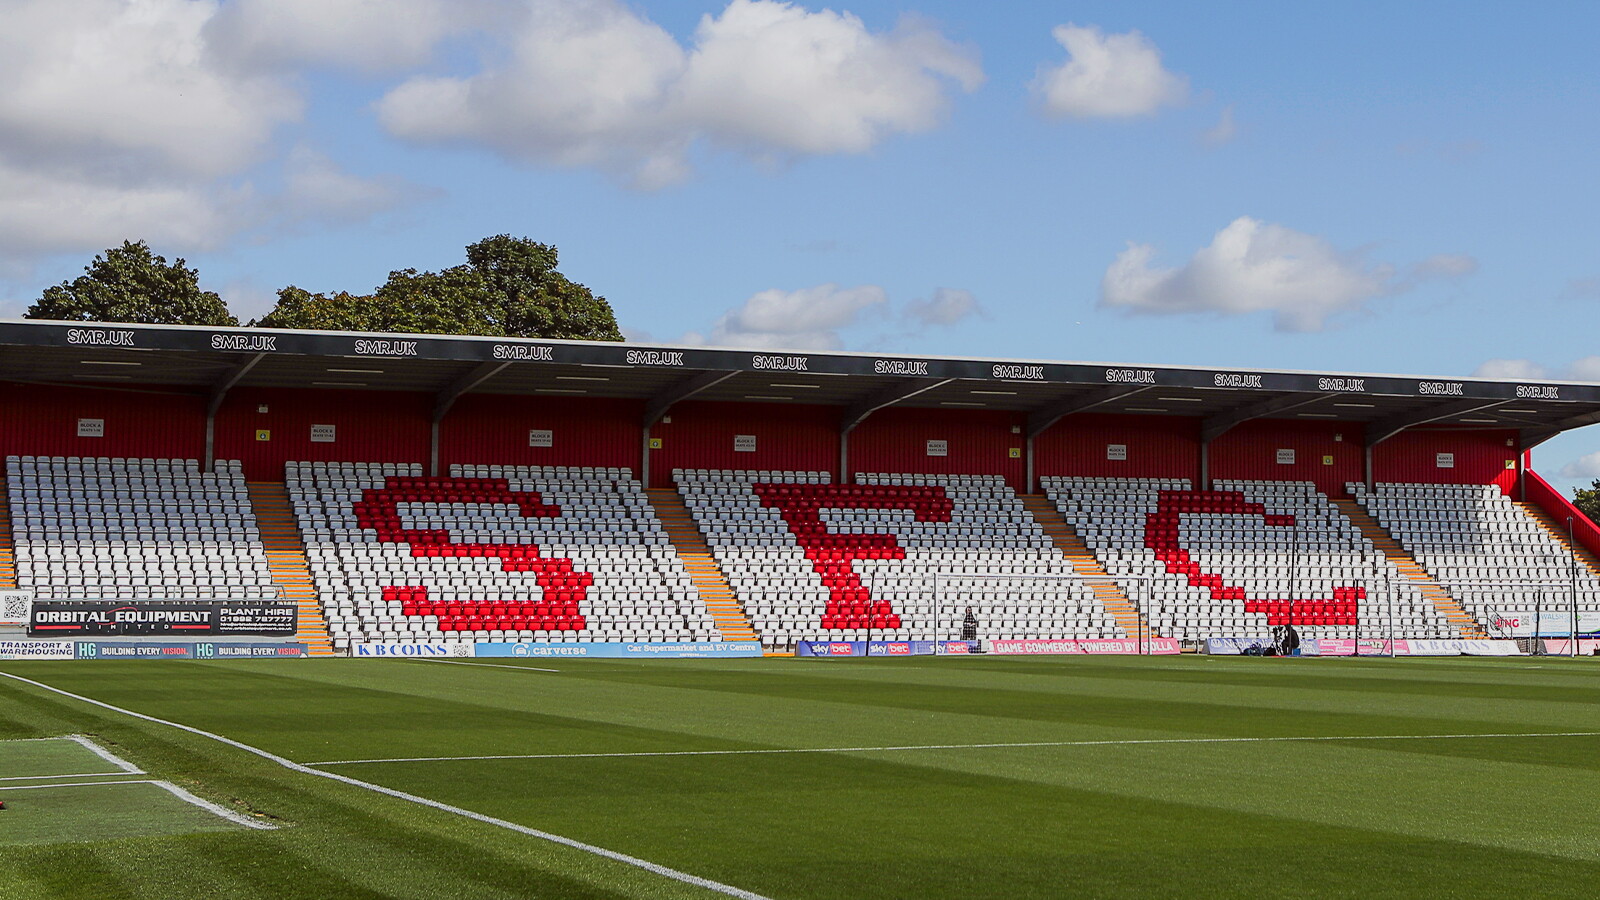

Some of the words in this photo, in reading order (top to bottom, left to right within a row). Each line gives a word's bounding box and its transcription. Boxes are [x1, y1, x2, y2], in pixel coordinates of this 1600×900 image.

[67, 329, 134, 346] SMR.UK
[211, 334, 276, 351] SMR.UK
[354, 339, 417, 356] SMR.UK
[493, 344, 553, 361] SMR.UK
[626, 350, 683, 366] SMR.UK
[752, 355, 808, 371] SMR.UK
[874, 360, 928, 375] SMR.UK
[992, 364, 1044, 380] SMR.UK
[1105, 369, 1155, 384] SMR.UK
[1214, 373, 1262, 388] SMR.UK
[1318, 378, 1365, 392] SMR.UK
[1418, 382, 1463, 396] SMR.UK
[1516, 385, 1559, 399] SMR.UK
[35, 611, 110, 622] ORBITAL
[115, 611, 212, 623] EQUIPMENT
[220, 608, 261, 616] PLANT
[265, 608, 293, 616] HIRE
[0, 648, 73, 656] WAREHOUSING
[79, 642, 97, 657] HG
[102, 647, 135, 655] BUILDING
[137, 647, 160, 655] EVERY
[196, 643, 214, 657] HG
[218, 647, 251, 655] BUILDING
[253, 647, 276, 655] EVERY
[533, 646, 587, 655] carverse
[627, 644, 642, 652] Car
[643, 644, 697, 653] Supermarket
[698, 644, 715, 652] and
[716, 644, 728, 652] EV
[729, 644, 756, 652] Centre
[811, 645, 830, 654] sky
[831, 644, 851, 653] bet
[870, 645, 888, 654] sky
[889, 644, 909, 653] bet
[948, 643, 966, 652] bet
[997, 643, 1023, 653] GAME
[1025, 642, 1077, 652] COMMERCE
[1079, 642, 1122, 652] POWERED
[1125, 642, 1136, 652] BY
